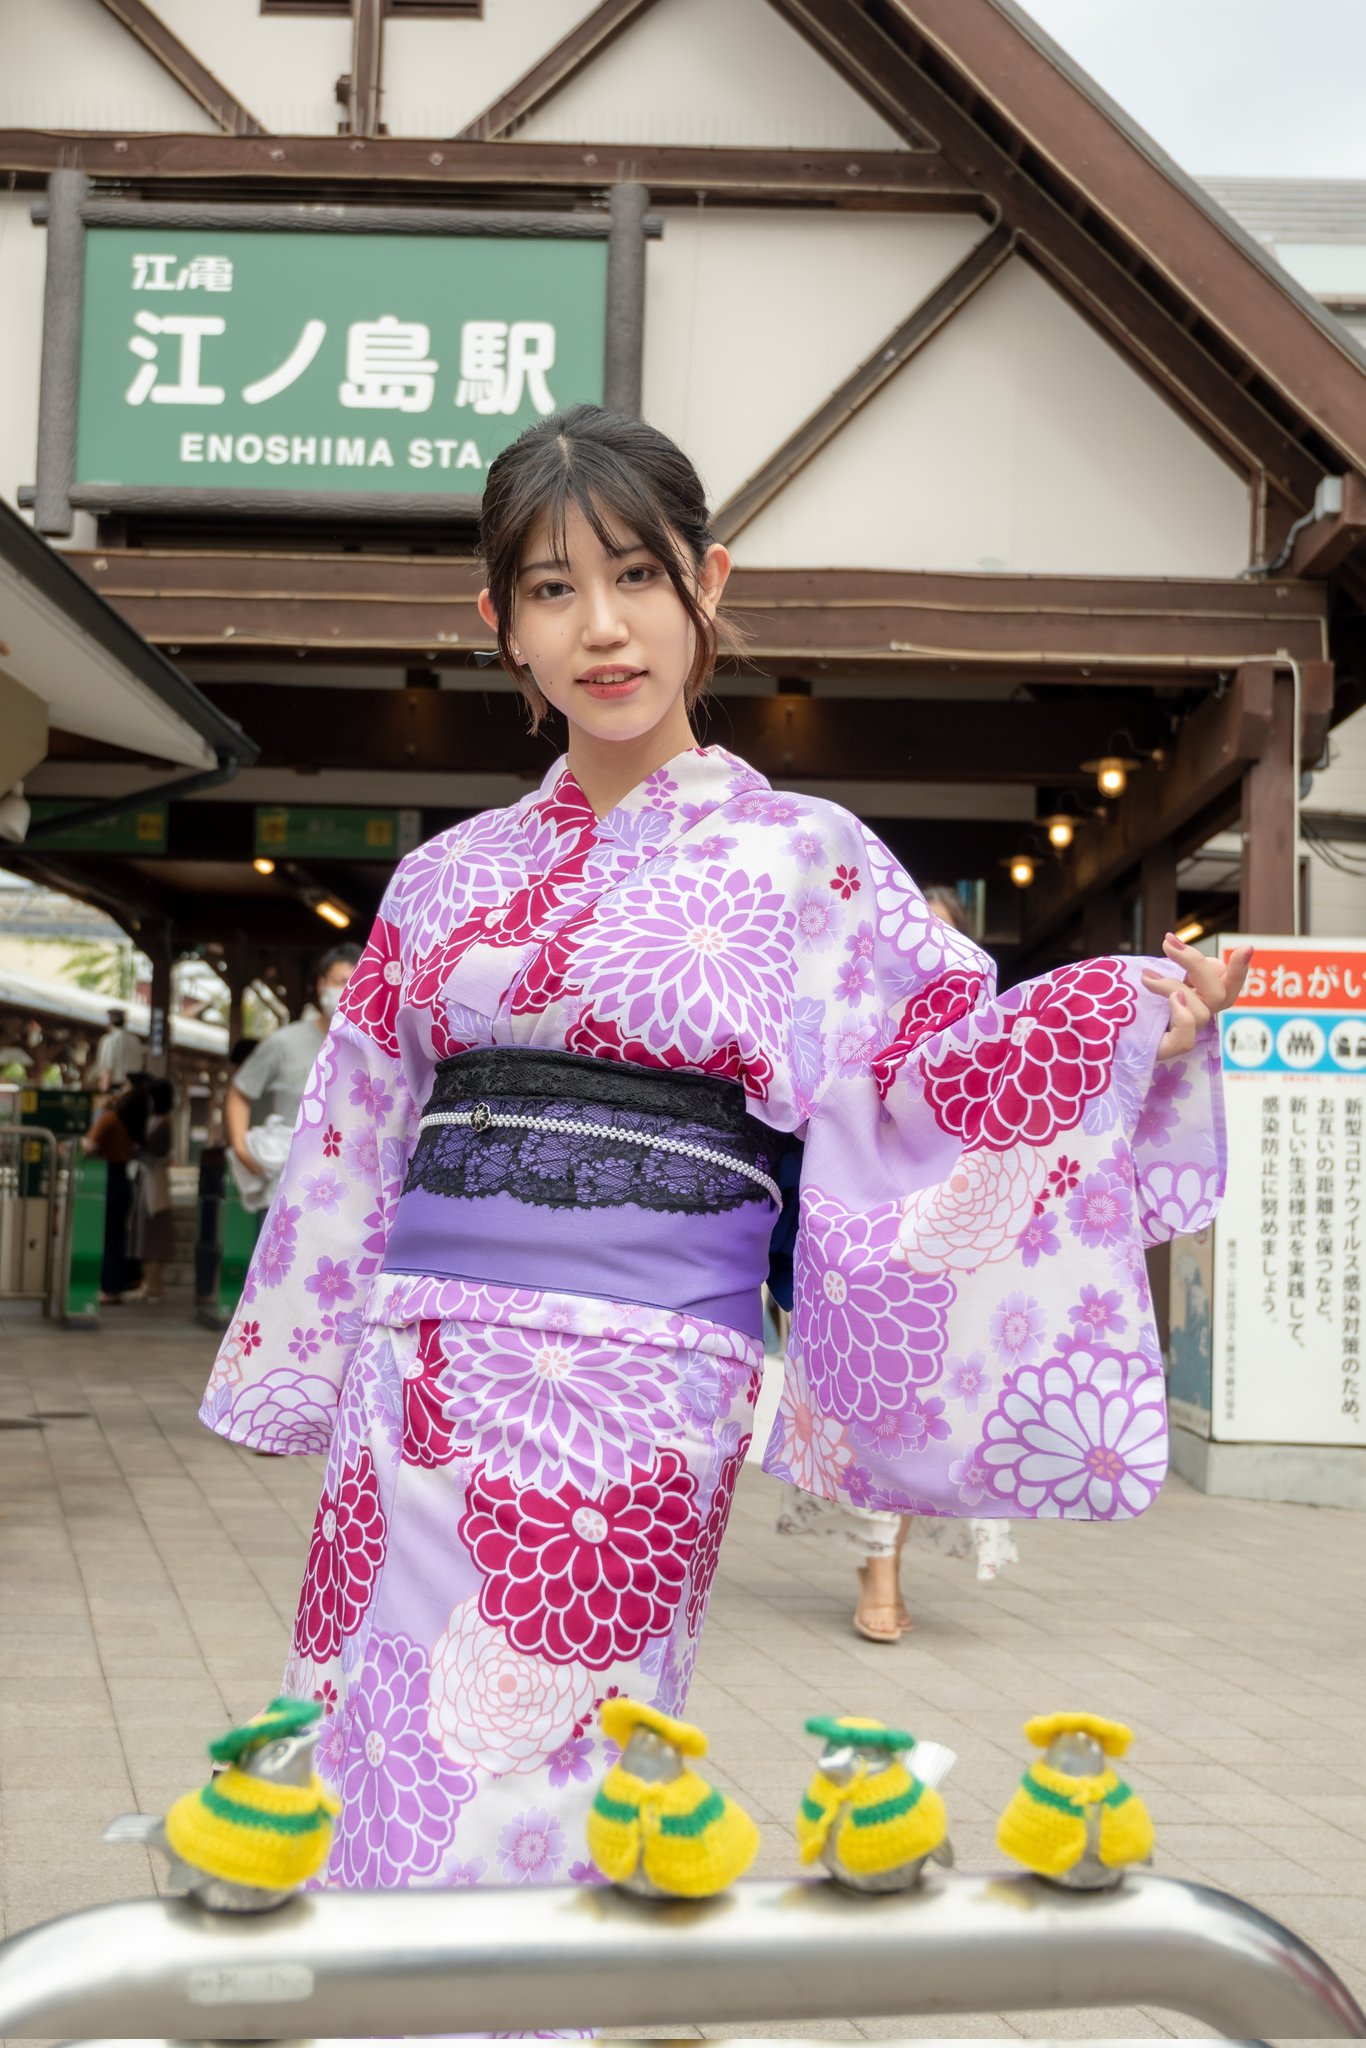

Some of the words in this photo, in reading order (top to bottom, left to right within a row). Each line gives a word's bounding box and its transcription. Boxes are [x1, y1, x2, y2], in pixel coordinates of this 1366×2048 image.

[132, 254, 234, 292] 江ノ電
[125, 309, 556, 416] 江ノ島駅
[180, 433, 395, 467] ENOSHIMA
[1238, 963, 1366, 1000] おねがい
[1260, 1095, 1280, 1324] 感染防止に努めましょう。
[1287, 1096, 1308, 1349] 新しい生活様式を実践して、
[1314, 1097, 1336, 1324] お互いの距離を保つなど、
[1341, 1097, 1363, 1424] 新型コロナウイルス感染対策のため、
